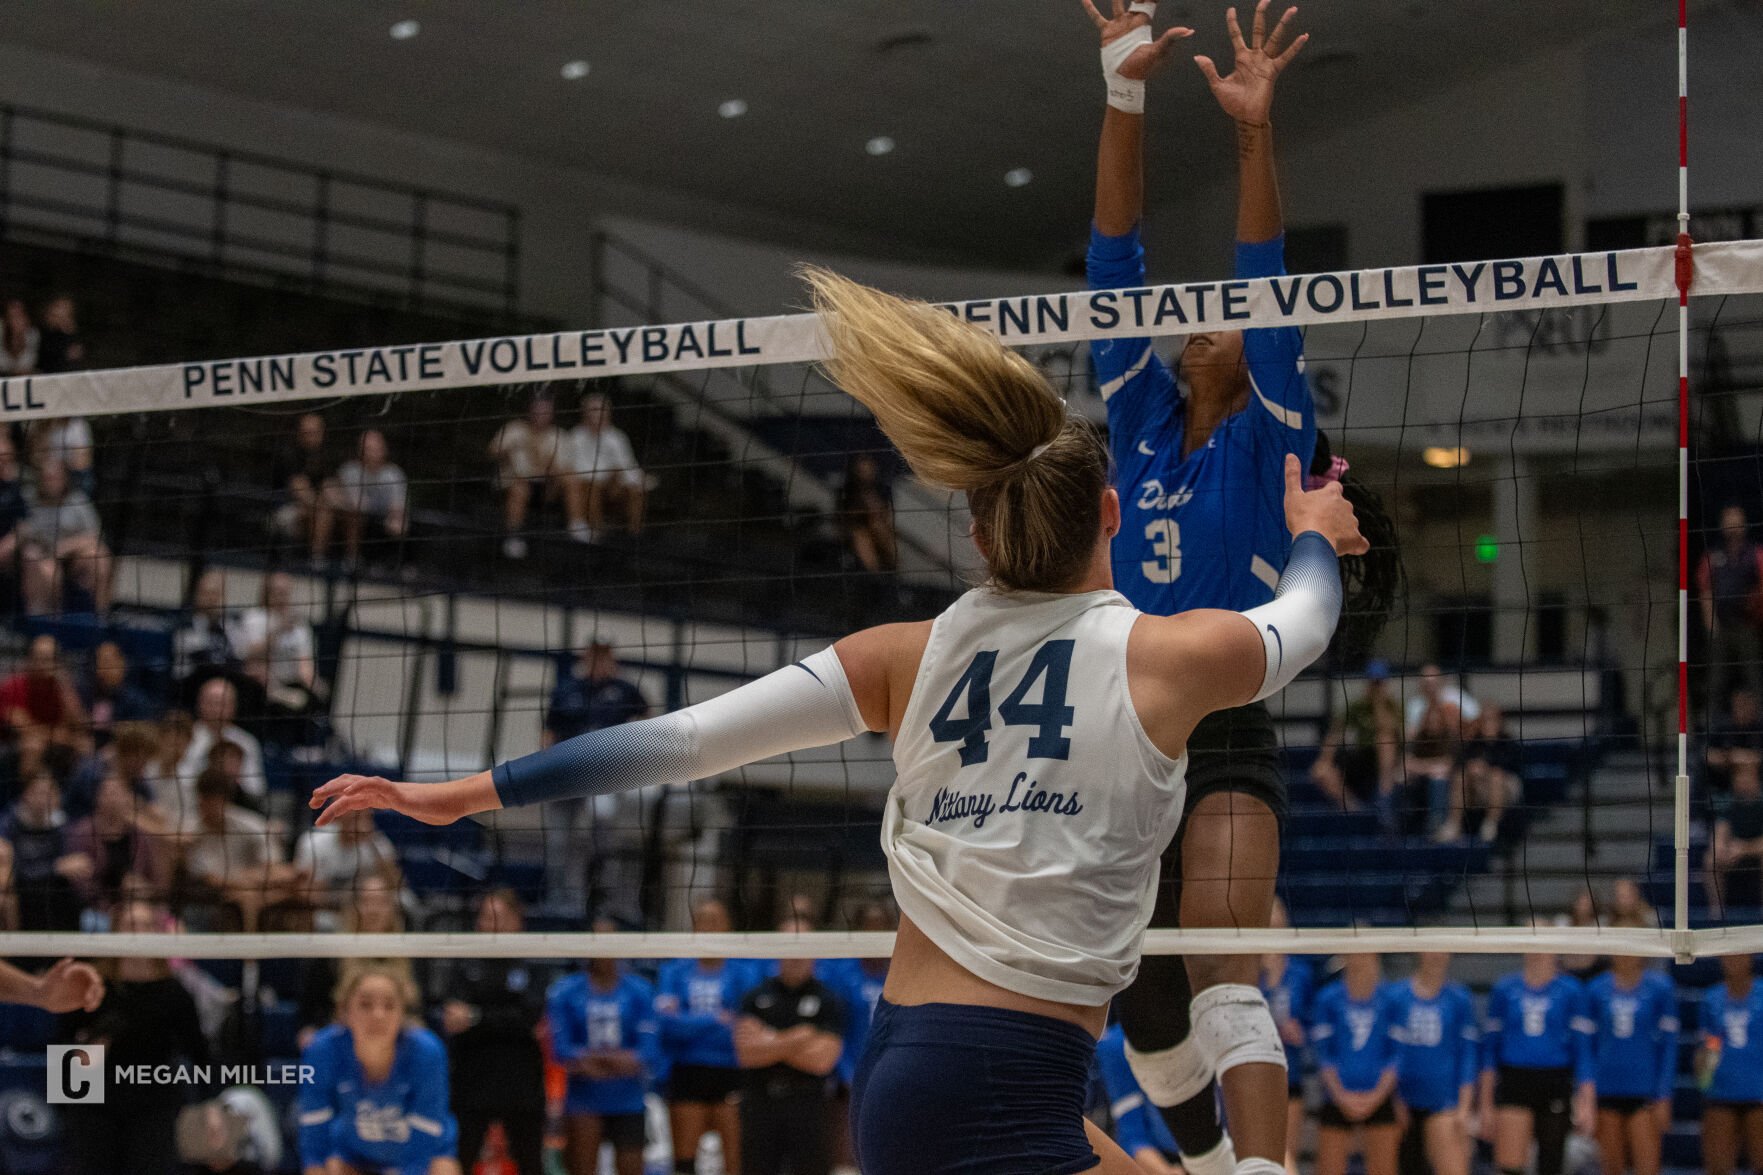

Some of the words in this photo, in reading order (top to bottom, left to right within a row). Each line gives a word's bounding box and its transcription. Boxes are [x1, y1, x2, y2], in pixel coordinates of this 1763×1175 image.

[1090, 282, 1250, 329] STATE
[1270, 252, 1637, 316] VOLLEYBALL
[184, 357, 295, 398] PENN
[312, 345, 444, 388] STATE
[461, 320, 760, 375] VOLLEYBALL
[1141, 518, 1182, 584] 3
[929, 639, 1076, 768] 44
[925, 785, 996, 829] Nittany
[999, 771, 1084, 816] Lions
